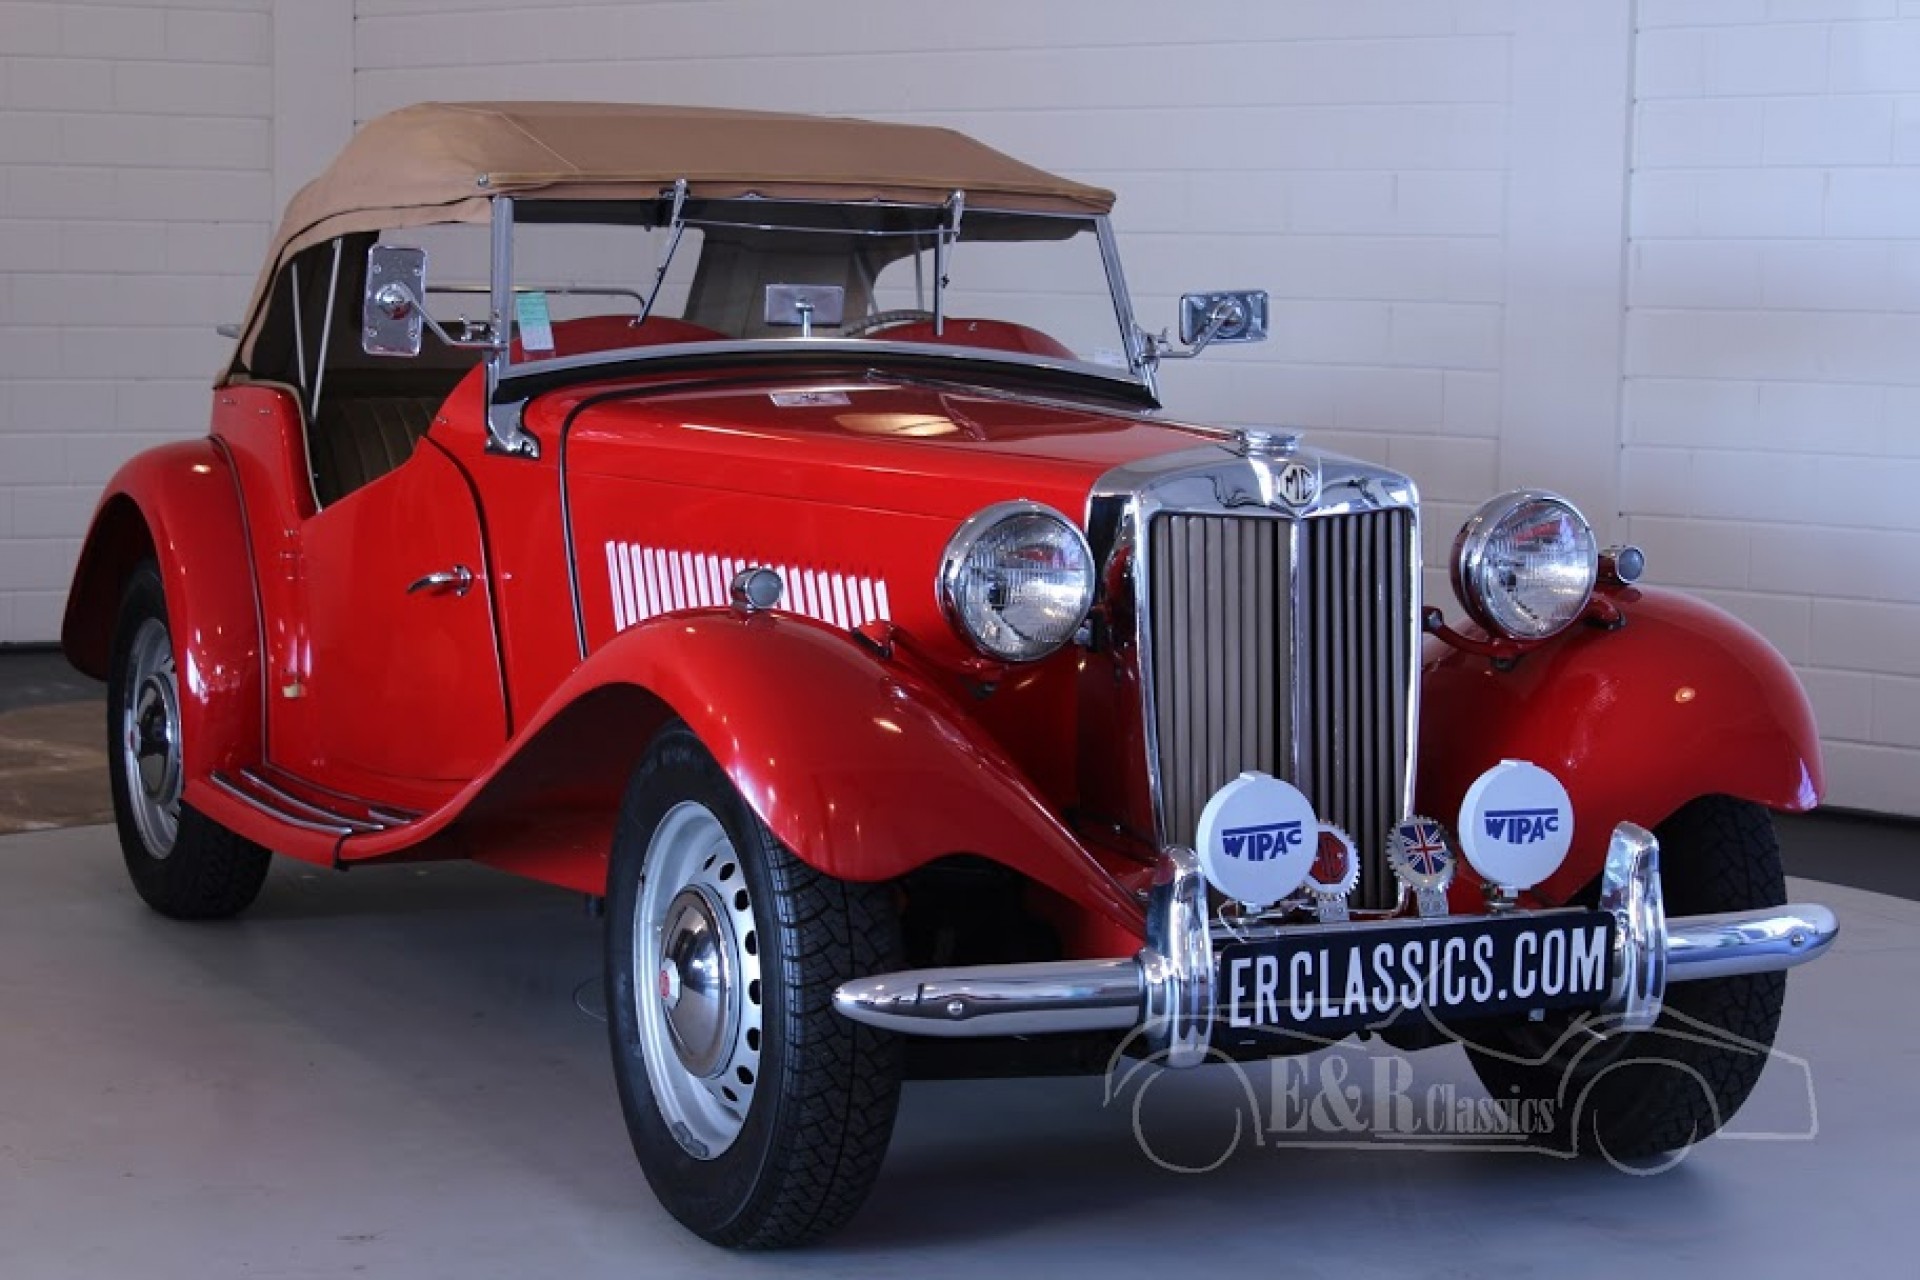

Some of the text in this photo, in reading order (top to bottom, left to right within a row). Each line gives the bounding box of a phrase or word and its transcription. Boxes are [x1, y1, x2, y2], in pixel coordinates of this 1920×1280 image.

[1283, 465, 1315, 501] MG
[1222, 828, 1302, 861] WIPAC
[1484, 816, 1559, 844] WIPAC
